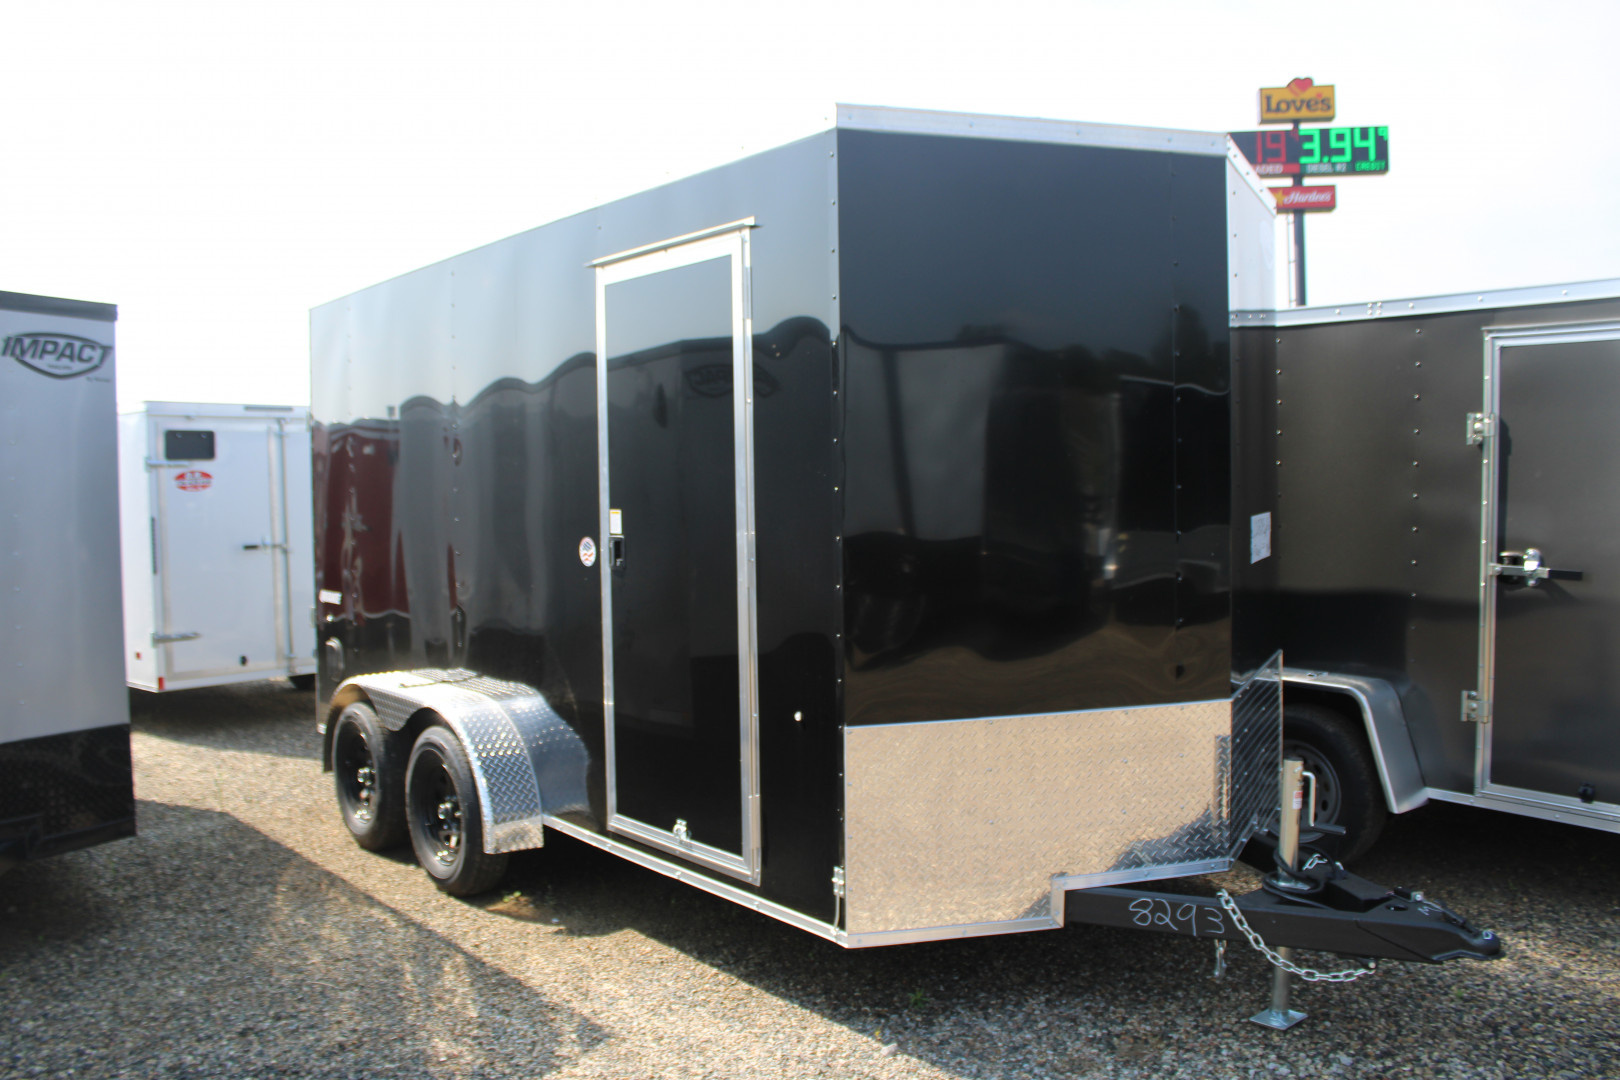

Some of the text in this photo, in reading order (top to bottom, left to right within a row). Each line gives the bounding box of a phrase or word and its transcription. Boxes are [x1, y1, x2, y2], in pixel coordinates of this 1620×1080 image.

[1265, 93, 1332, 113] Love's
[1, 336, 113, 366] IMPACT
[1128, 898, 1225, 937] 8293
